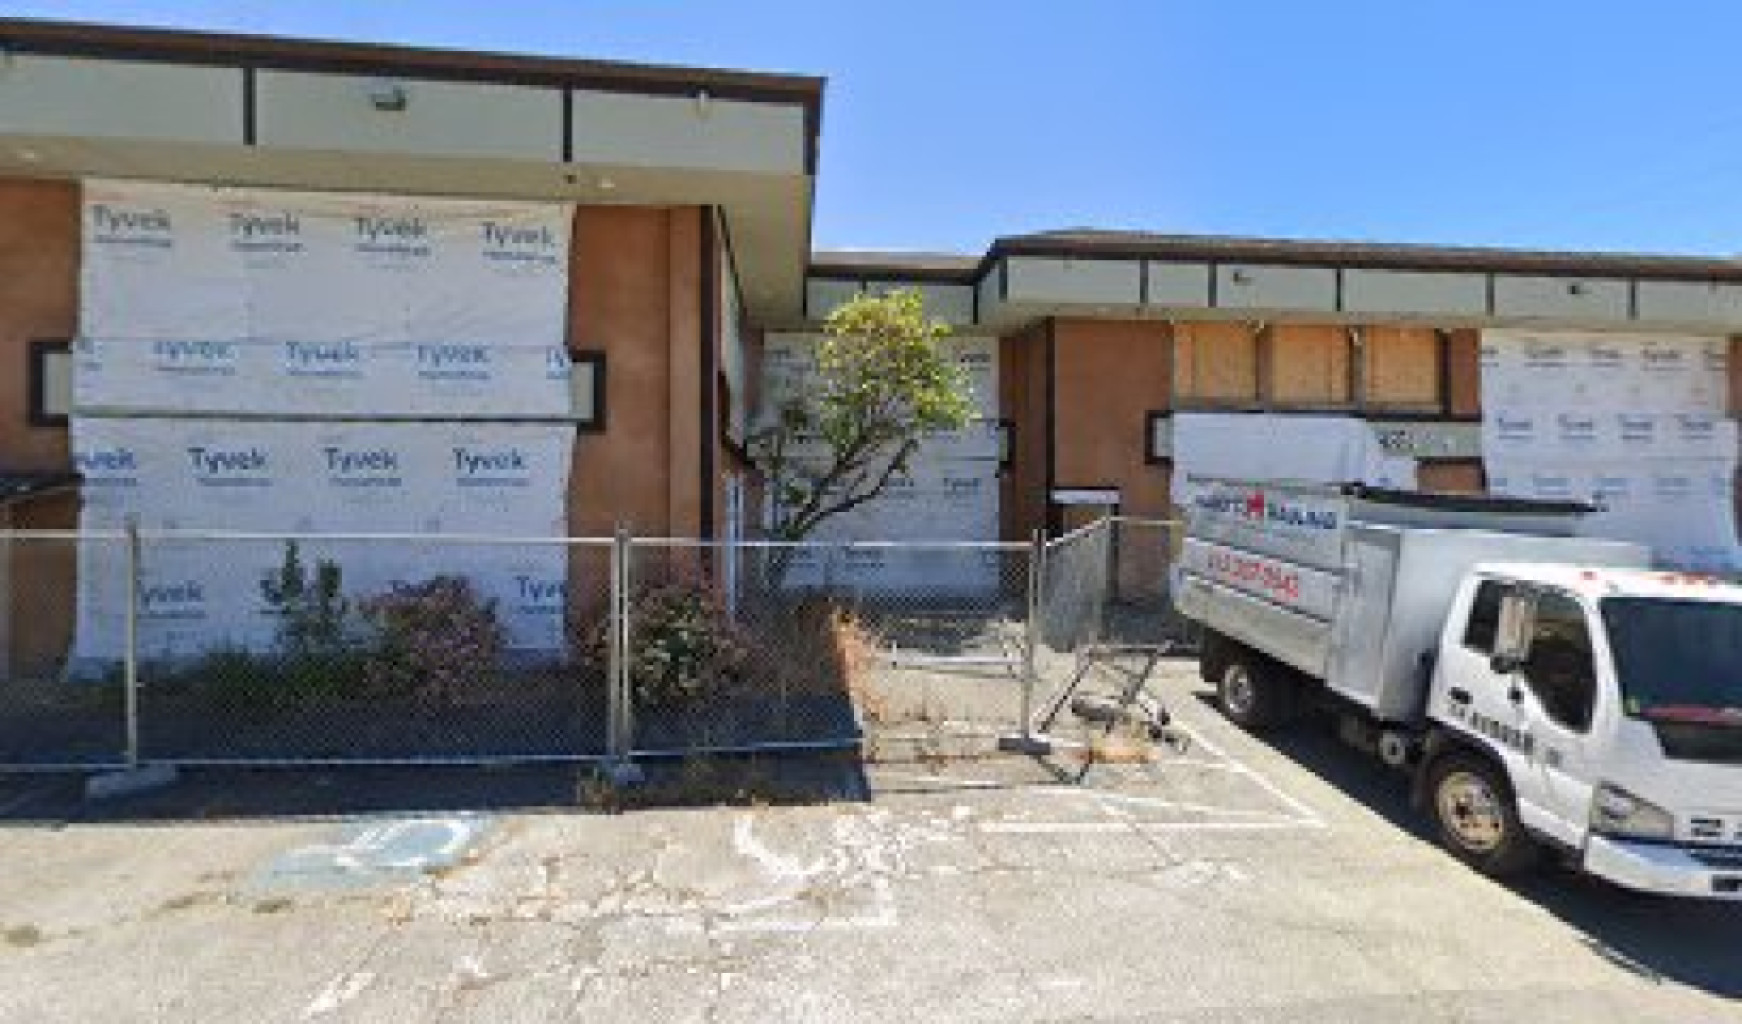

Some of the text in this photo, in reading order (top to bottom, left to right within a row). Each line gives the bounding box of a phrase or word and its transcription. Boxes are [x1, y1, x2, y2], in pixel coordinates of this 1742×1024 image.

[93, 204, 172, 233] Tyvek
[230, 210, 301, 236] Tyvek
[355, 216, 428, 241] Tyvek
[481, 220, 554, 248] Tyvek
[187, 447, 267, 473] Tyvek
[324, 447, 398, 473] Tyvek
[453, 447, 524, 474] Tyvek
[137, 579, 204, 607] yvek
